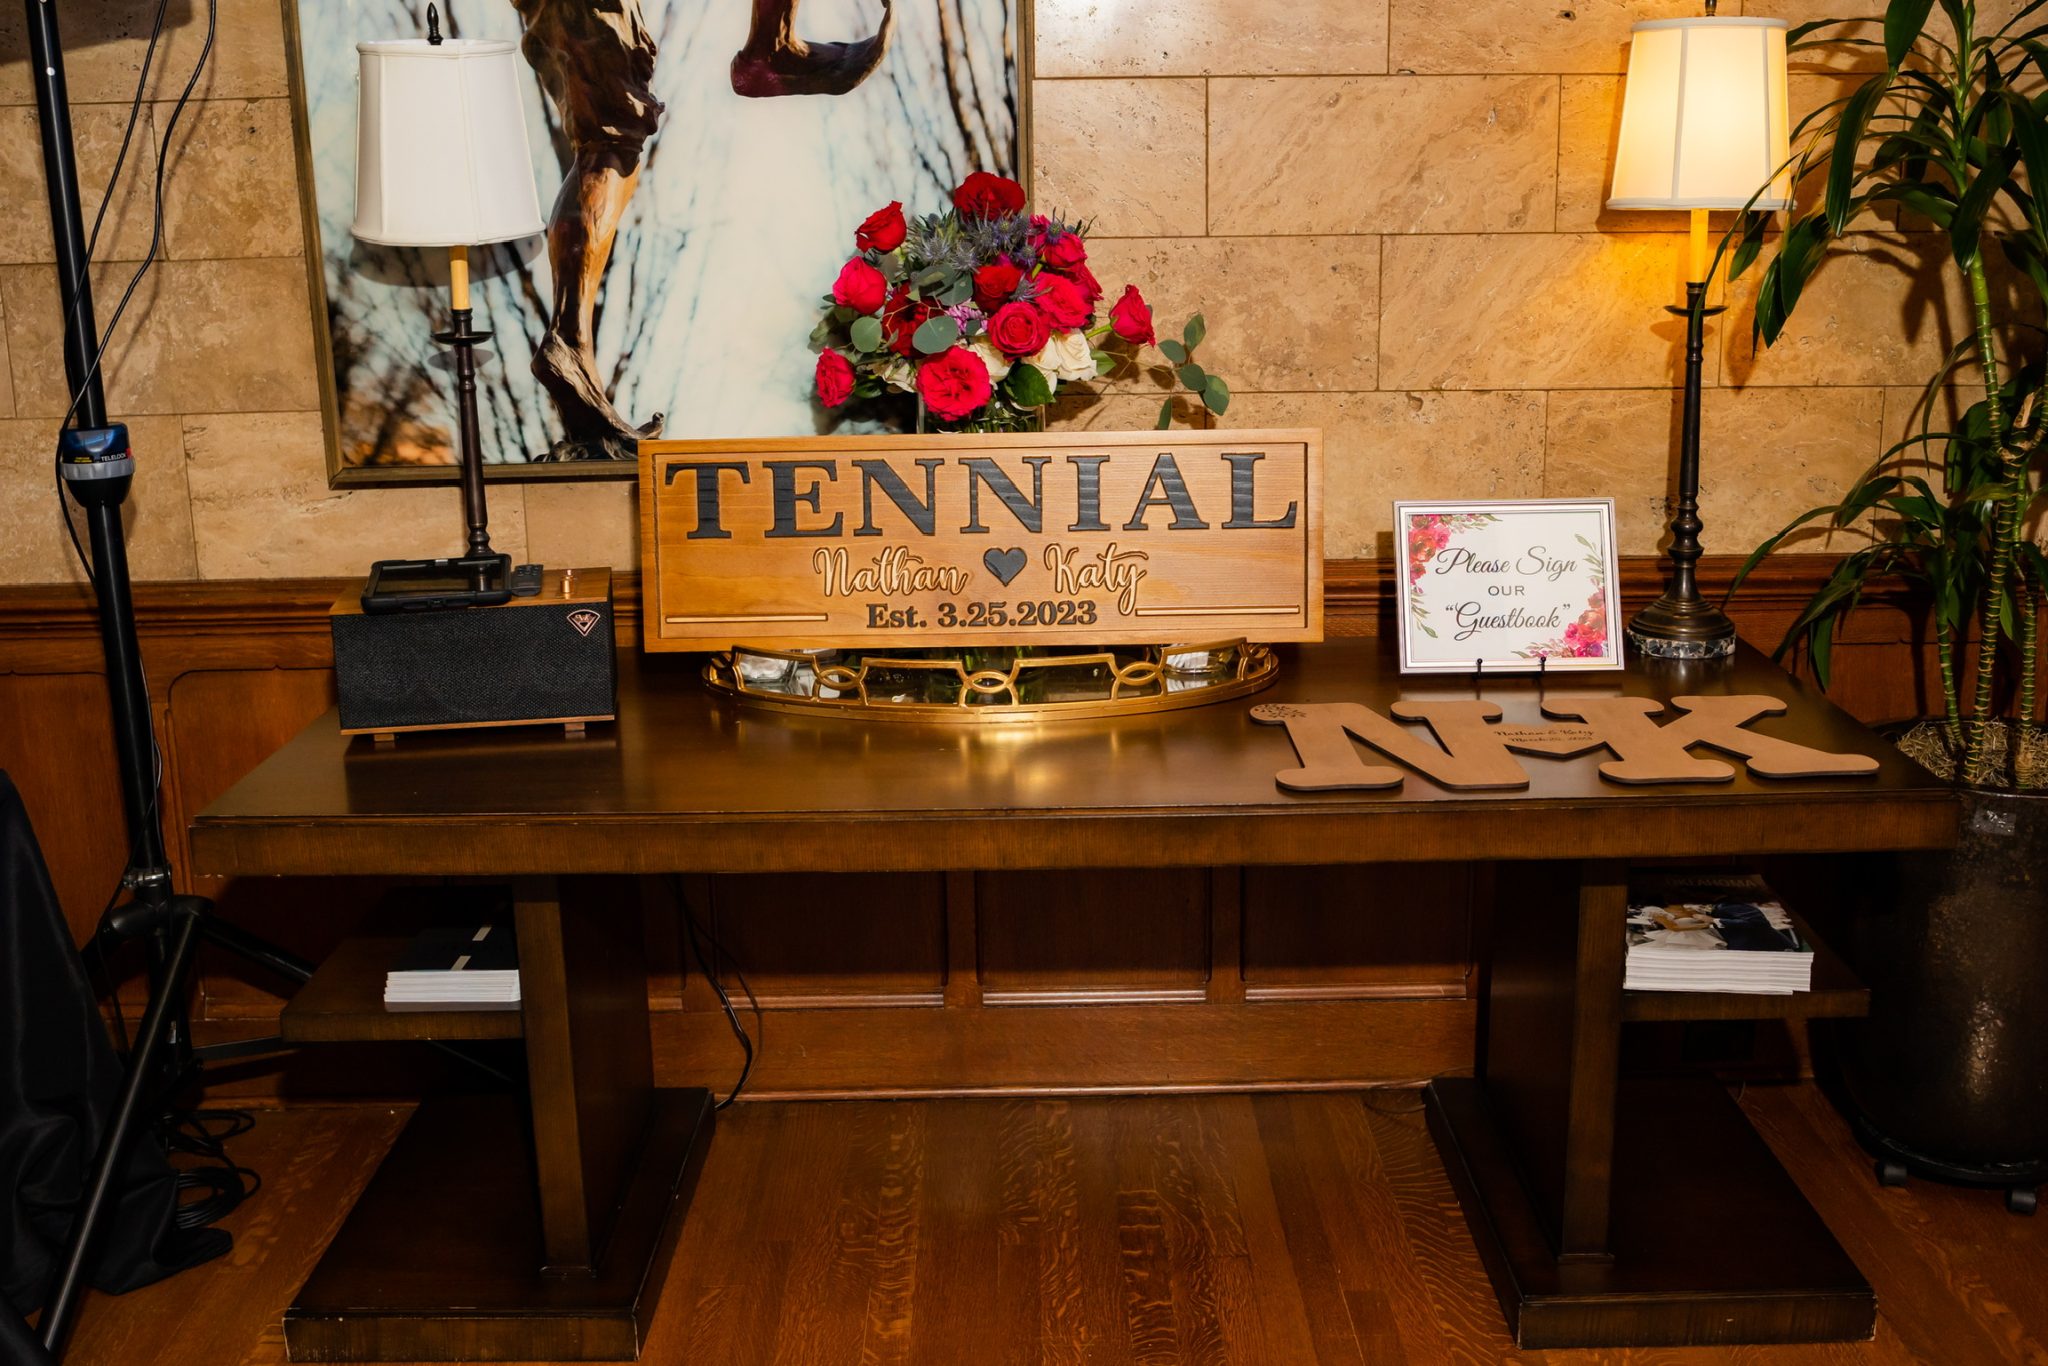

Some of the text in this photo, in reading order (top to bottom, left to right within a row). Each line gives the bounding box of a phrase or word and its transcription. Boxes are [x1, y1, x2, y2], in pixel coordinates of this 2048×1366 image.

[665, 452, 1298, 540] TENNIAL
[812, 543, 1149, 616] Nathan Katy
[1435, 546, 1577, 582] Please Sign
[1488, 586, 1526, 596] OUR
[867, 600, 1098, 629] Est. 3.25.2023
